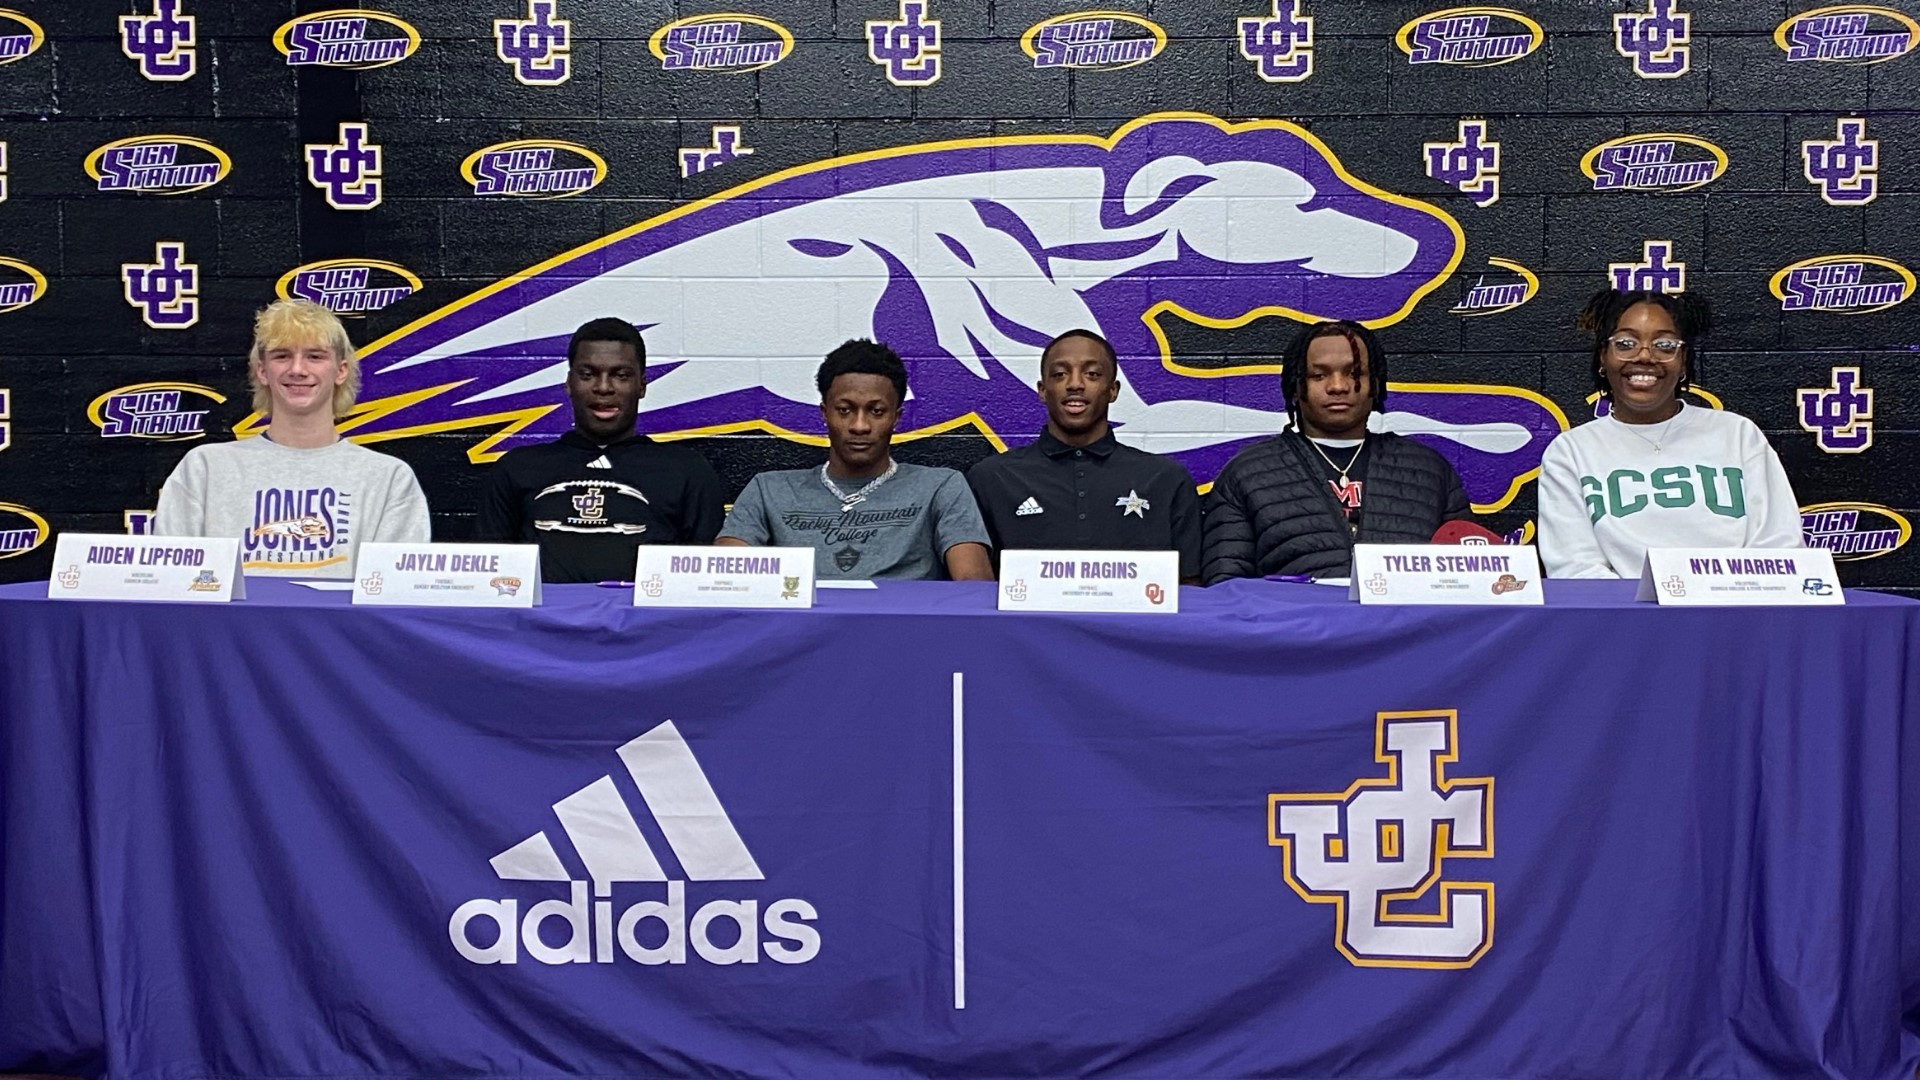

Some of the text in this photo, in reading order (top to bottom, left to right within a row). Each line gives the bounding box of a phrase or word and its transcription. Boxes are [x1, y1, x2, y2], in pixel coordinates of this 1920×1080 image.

[244, 487, 336, 551] JONES
[336, 491, 351, 545] COUNTY
[782, 503, 922, 534] Rocky Mountain
[824, 528, 878, 546] College
[87, 546, 205, 566] AIDEN LIPFORD
[243, 548, 334, 563] WRESTLING
[395, 553, 499, 573] JAYLN DEKLE
[670, 556, 781, 574] ROD FREEMAN
[1383, 556, 1510, 572] TYLER STEWART
[1040, 561, 1138, 579] ZION RAGINS
[1690, 558, 1797, 575] NYA WARREN
[1145, 583, 1164, 605] OU
[449, 880, 821, 966] adidas
